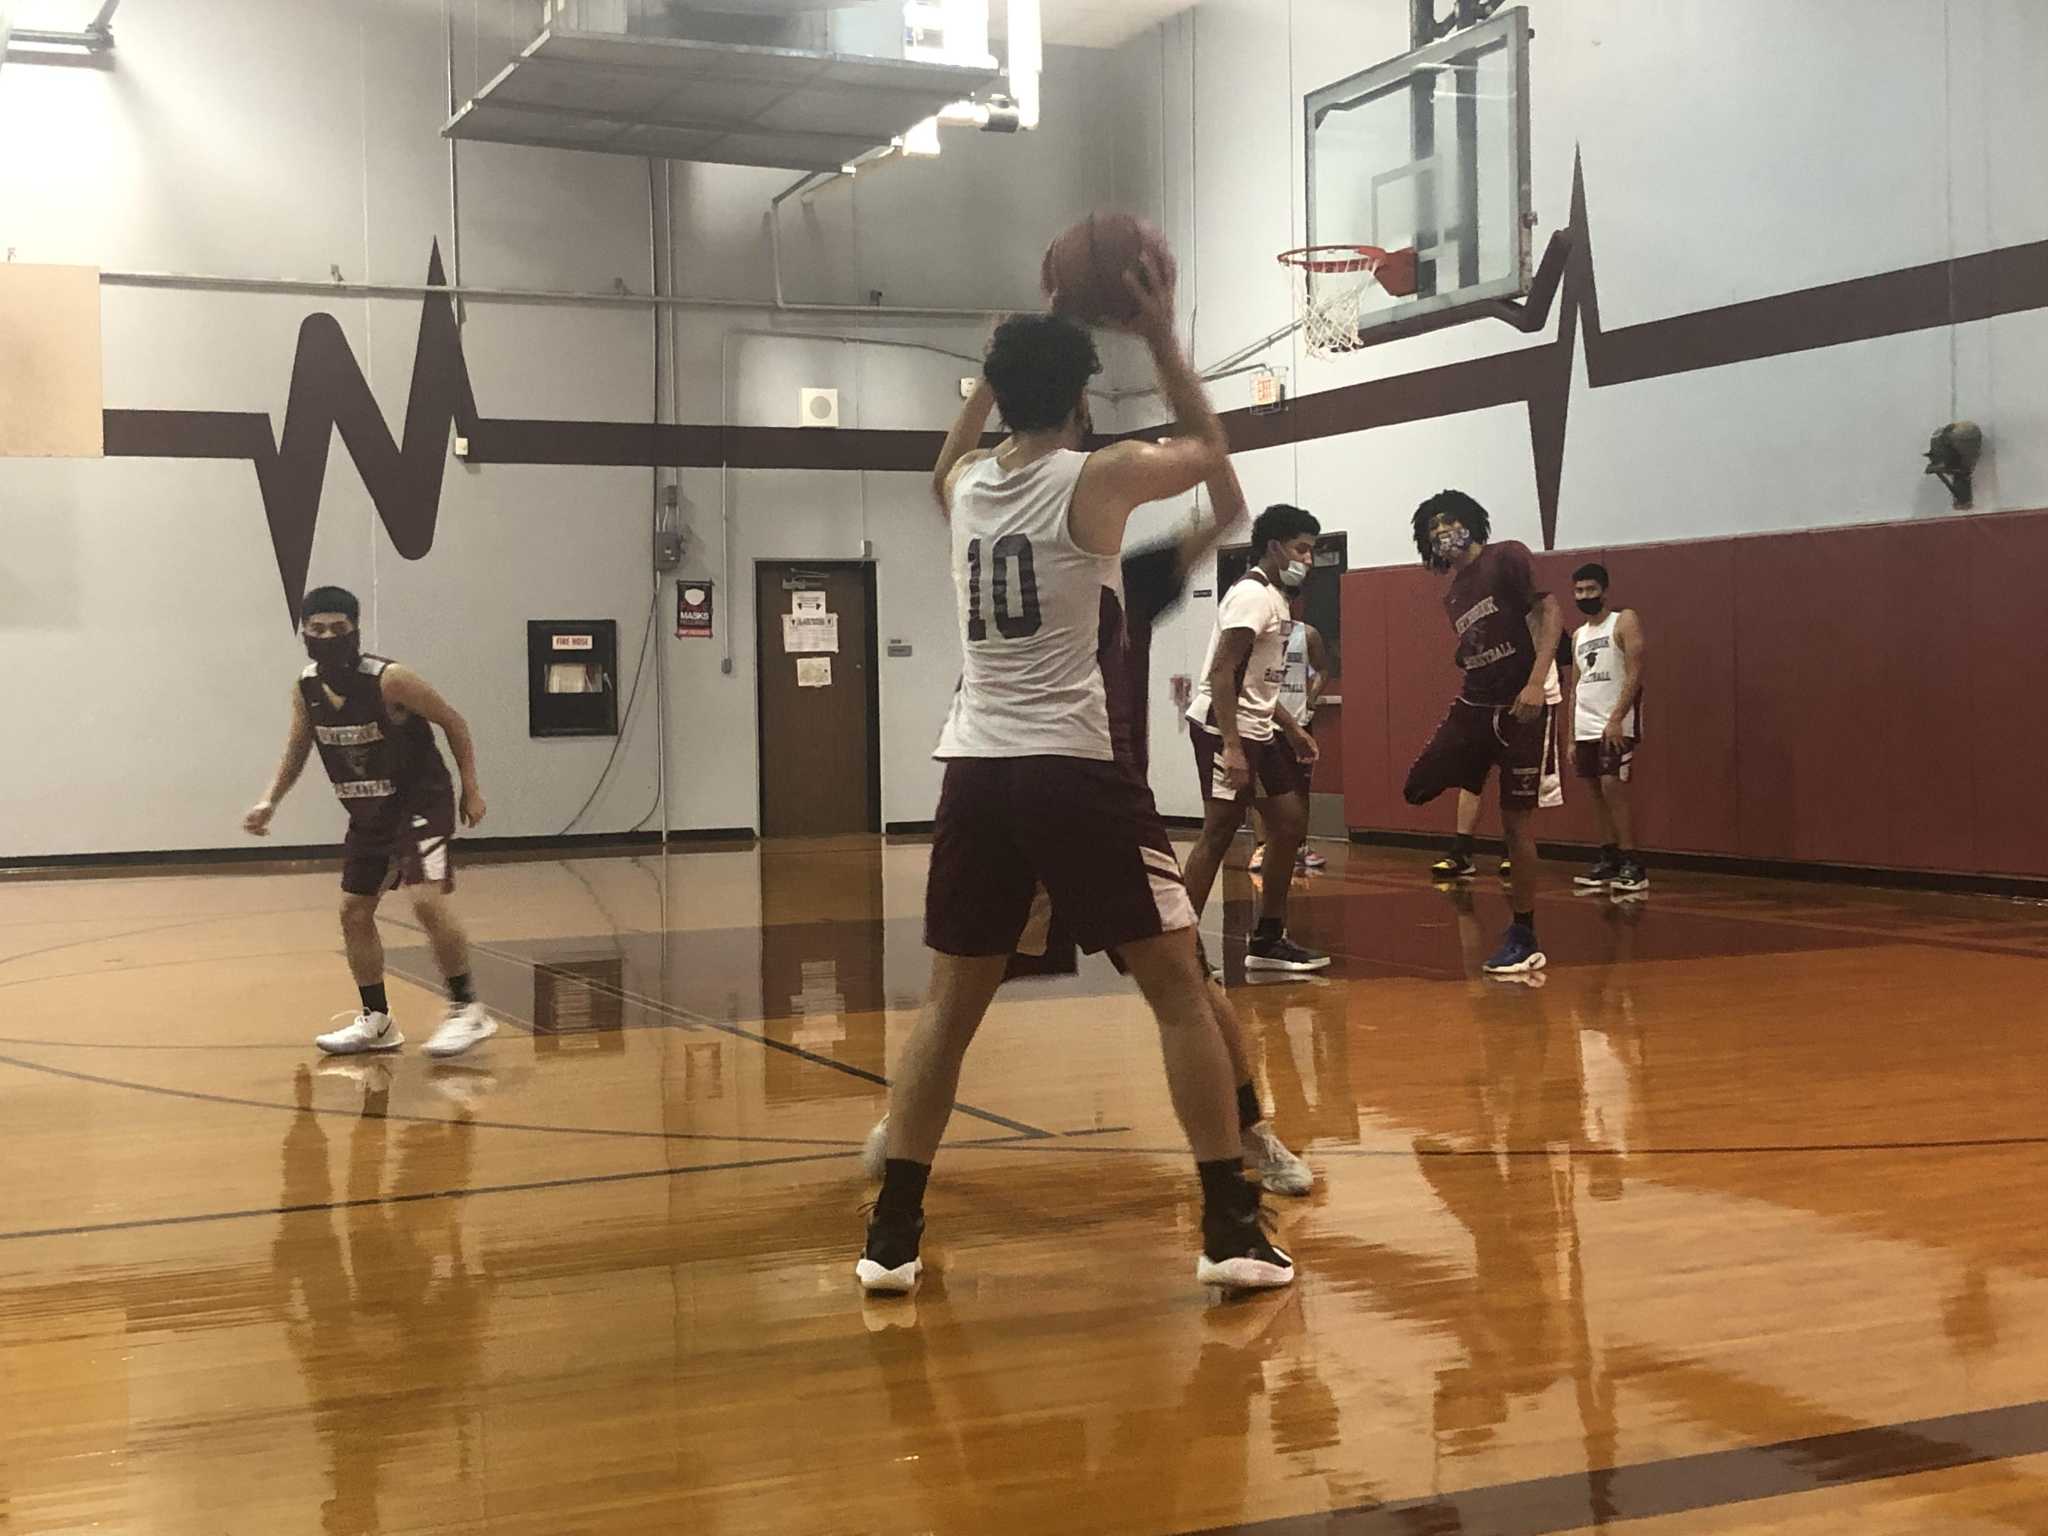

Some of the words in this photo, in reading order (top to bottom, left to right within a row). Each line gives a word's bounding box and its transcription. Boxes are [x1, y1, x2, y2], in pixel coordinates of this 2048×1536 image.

[967, 533, 1042, 641] 10
[680, 611, 709, 620] MASKS
[555, 637, 569, 646] FIRE
[571, 637, 588, 646] HOSE
